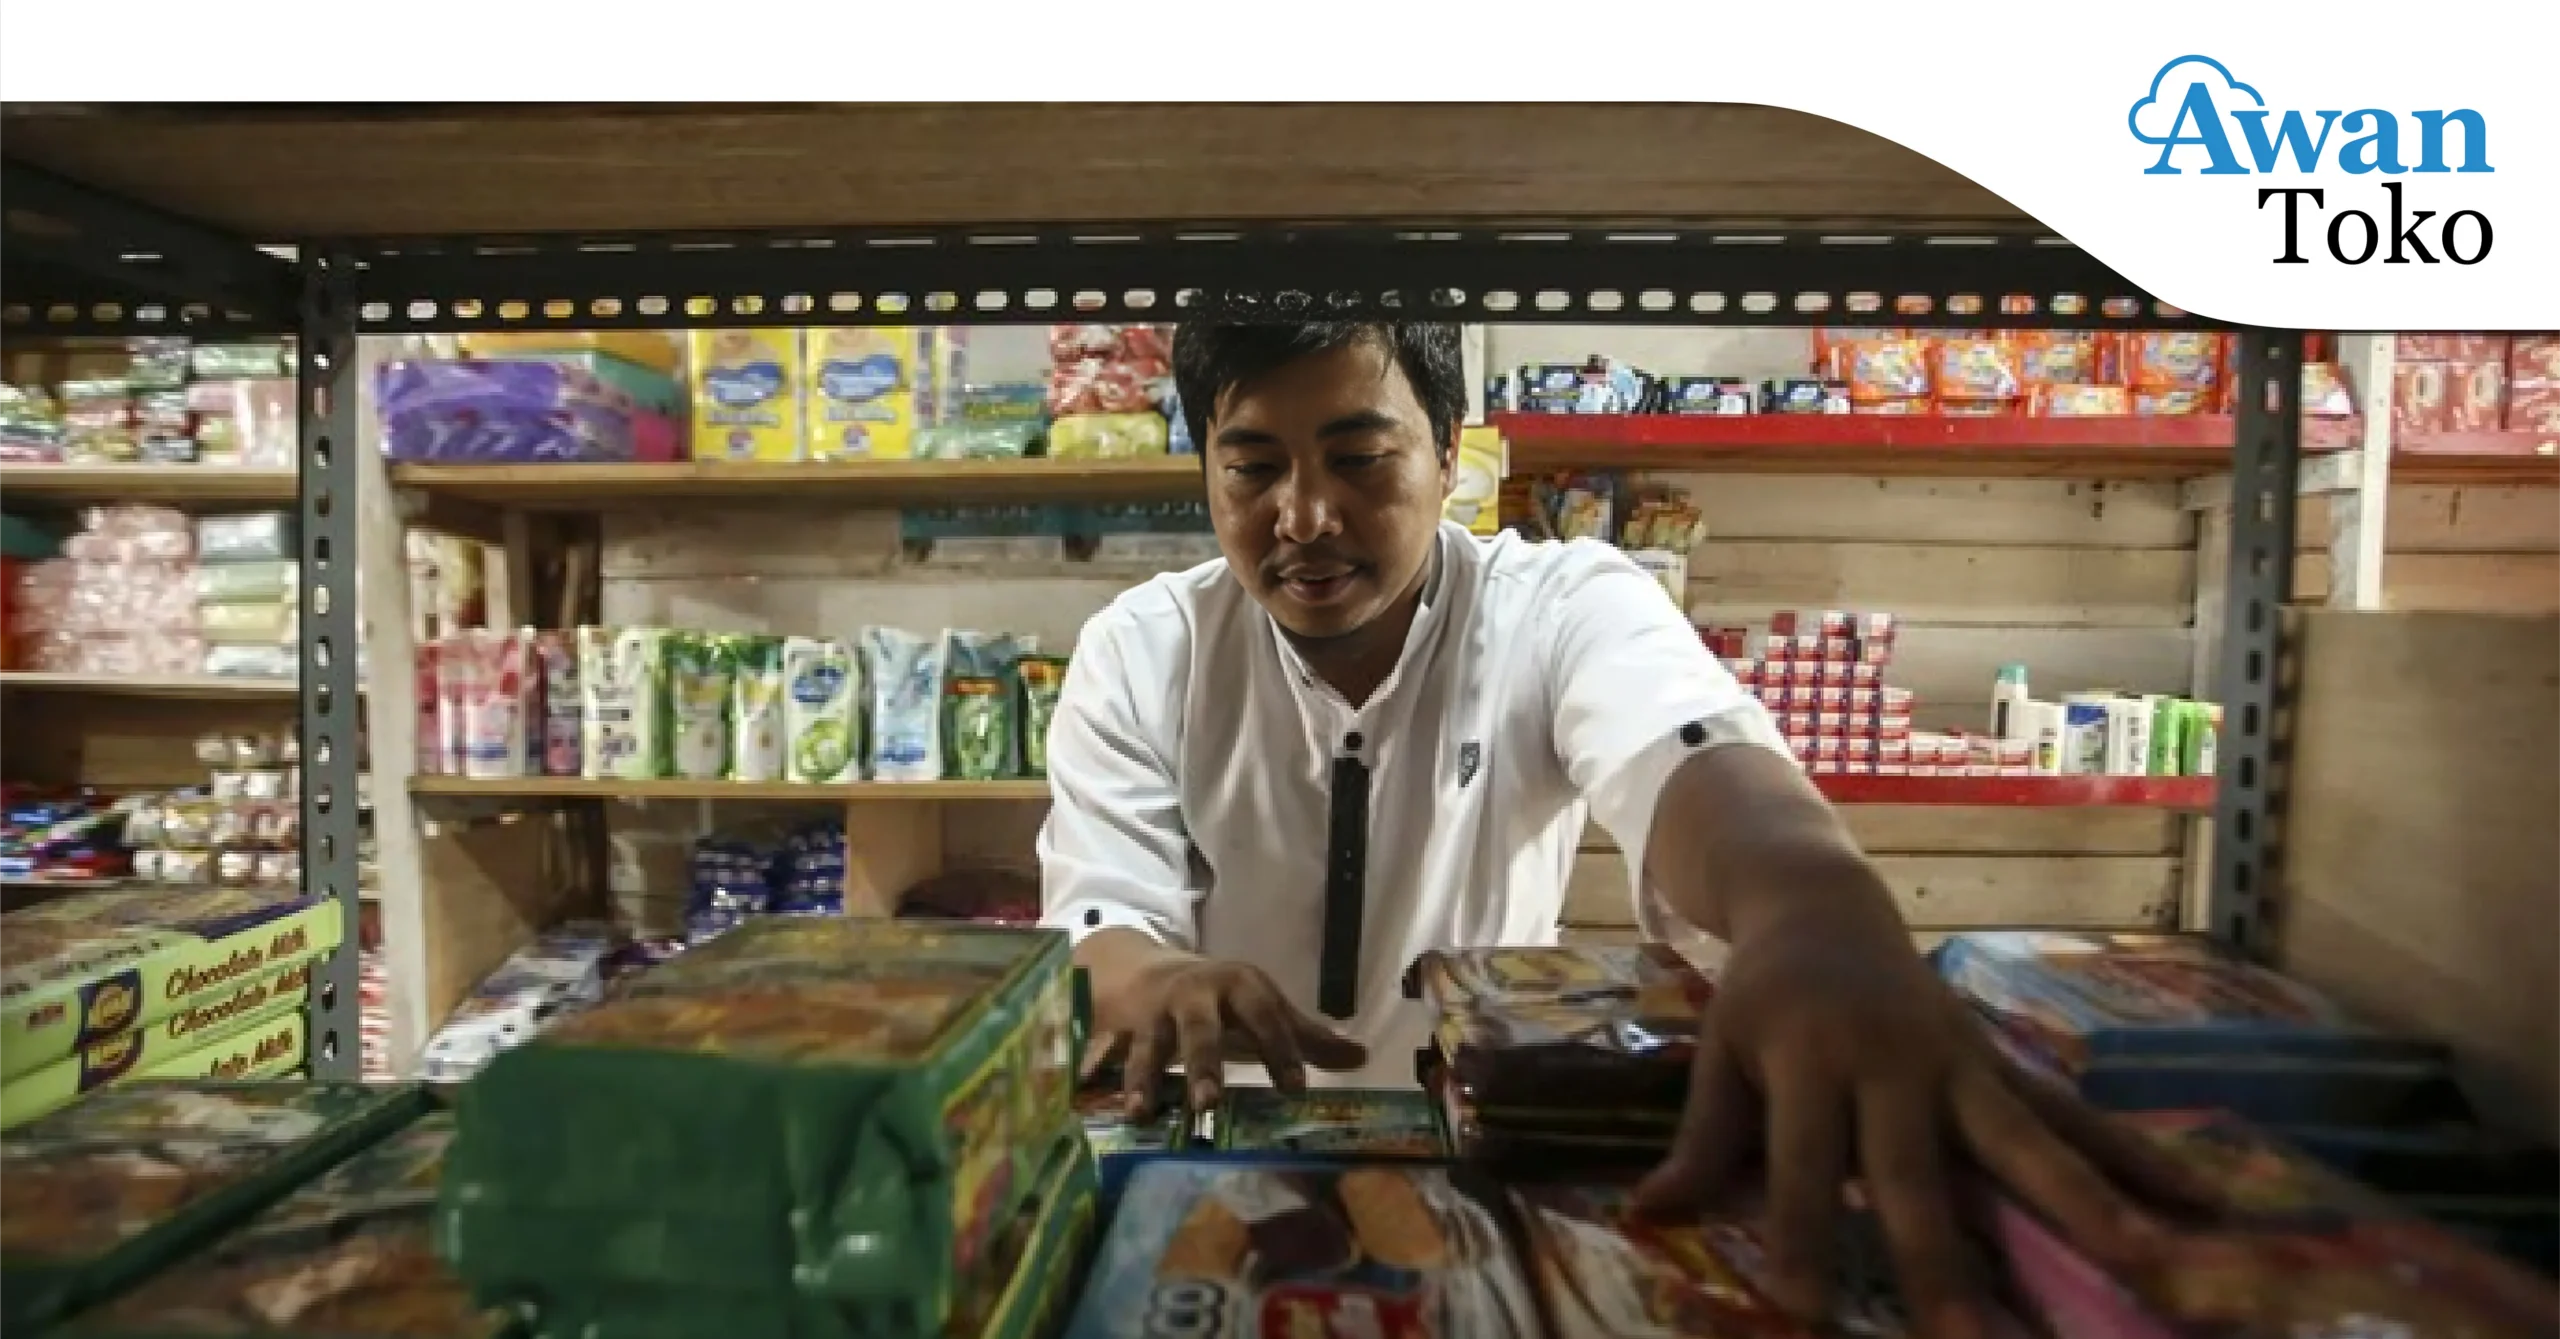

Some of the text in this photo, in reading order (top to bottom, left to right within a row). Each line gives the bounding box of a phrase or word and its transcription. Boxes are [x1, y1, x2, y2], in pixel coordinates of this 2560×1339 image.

[166, 945, 263, 999] Chocolate
[267, 923, 308, 960] Milk
[168, 984, 267, 1040] Chocolate
